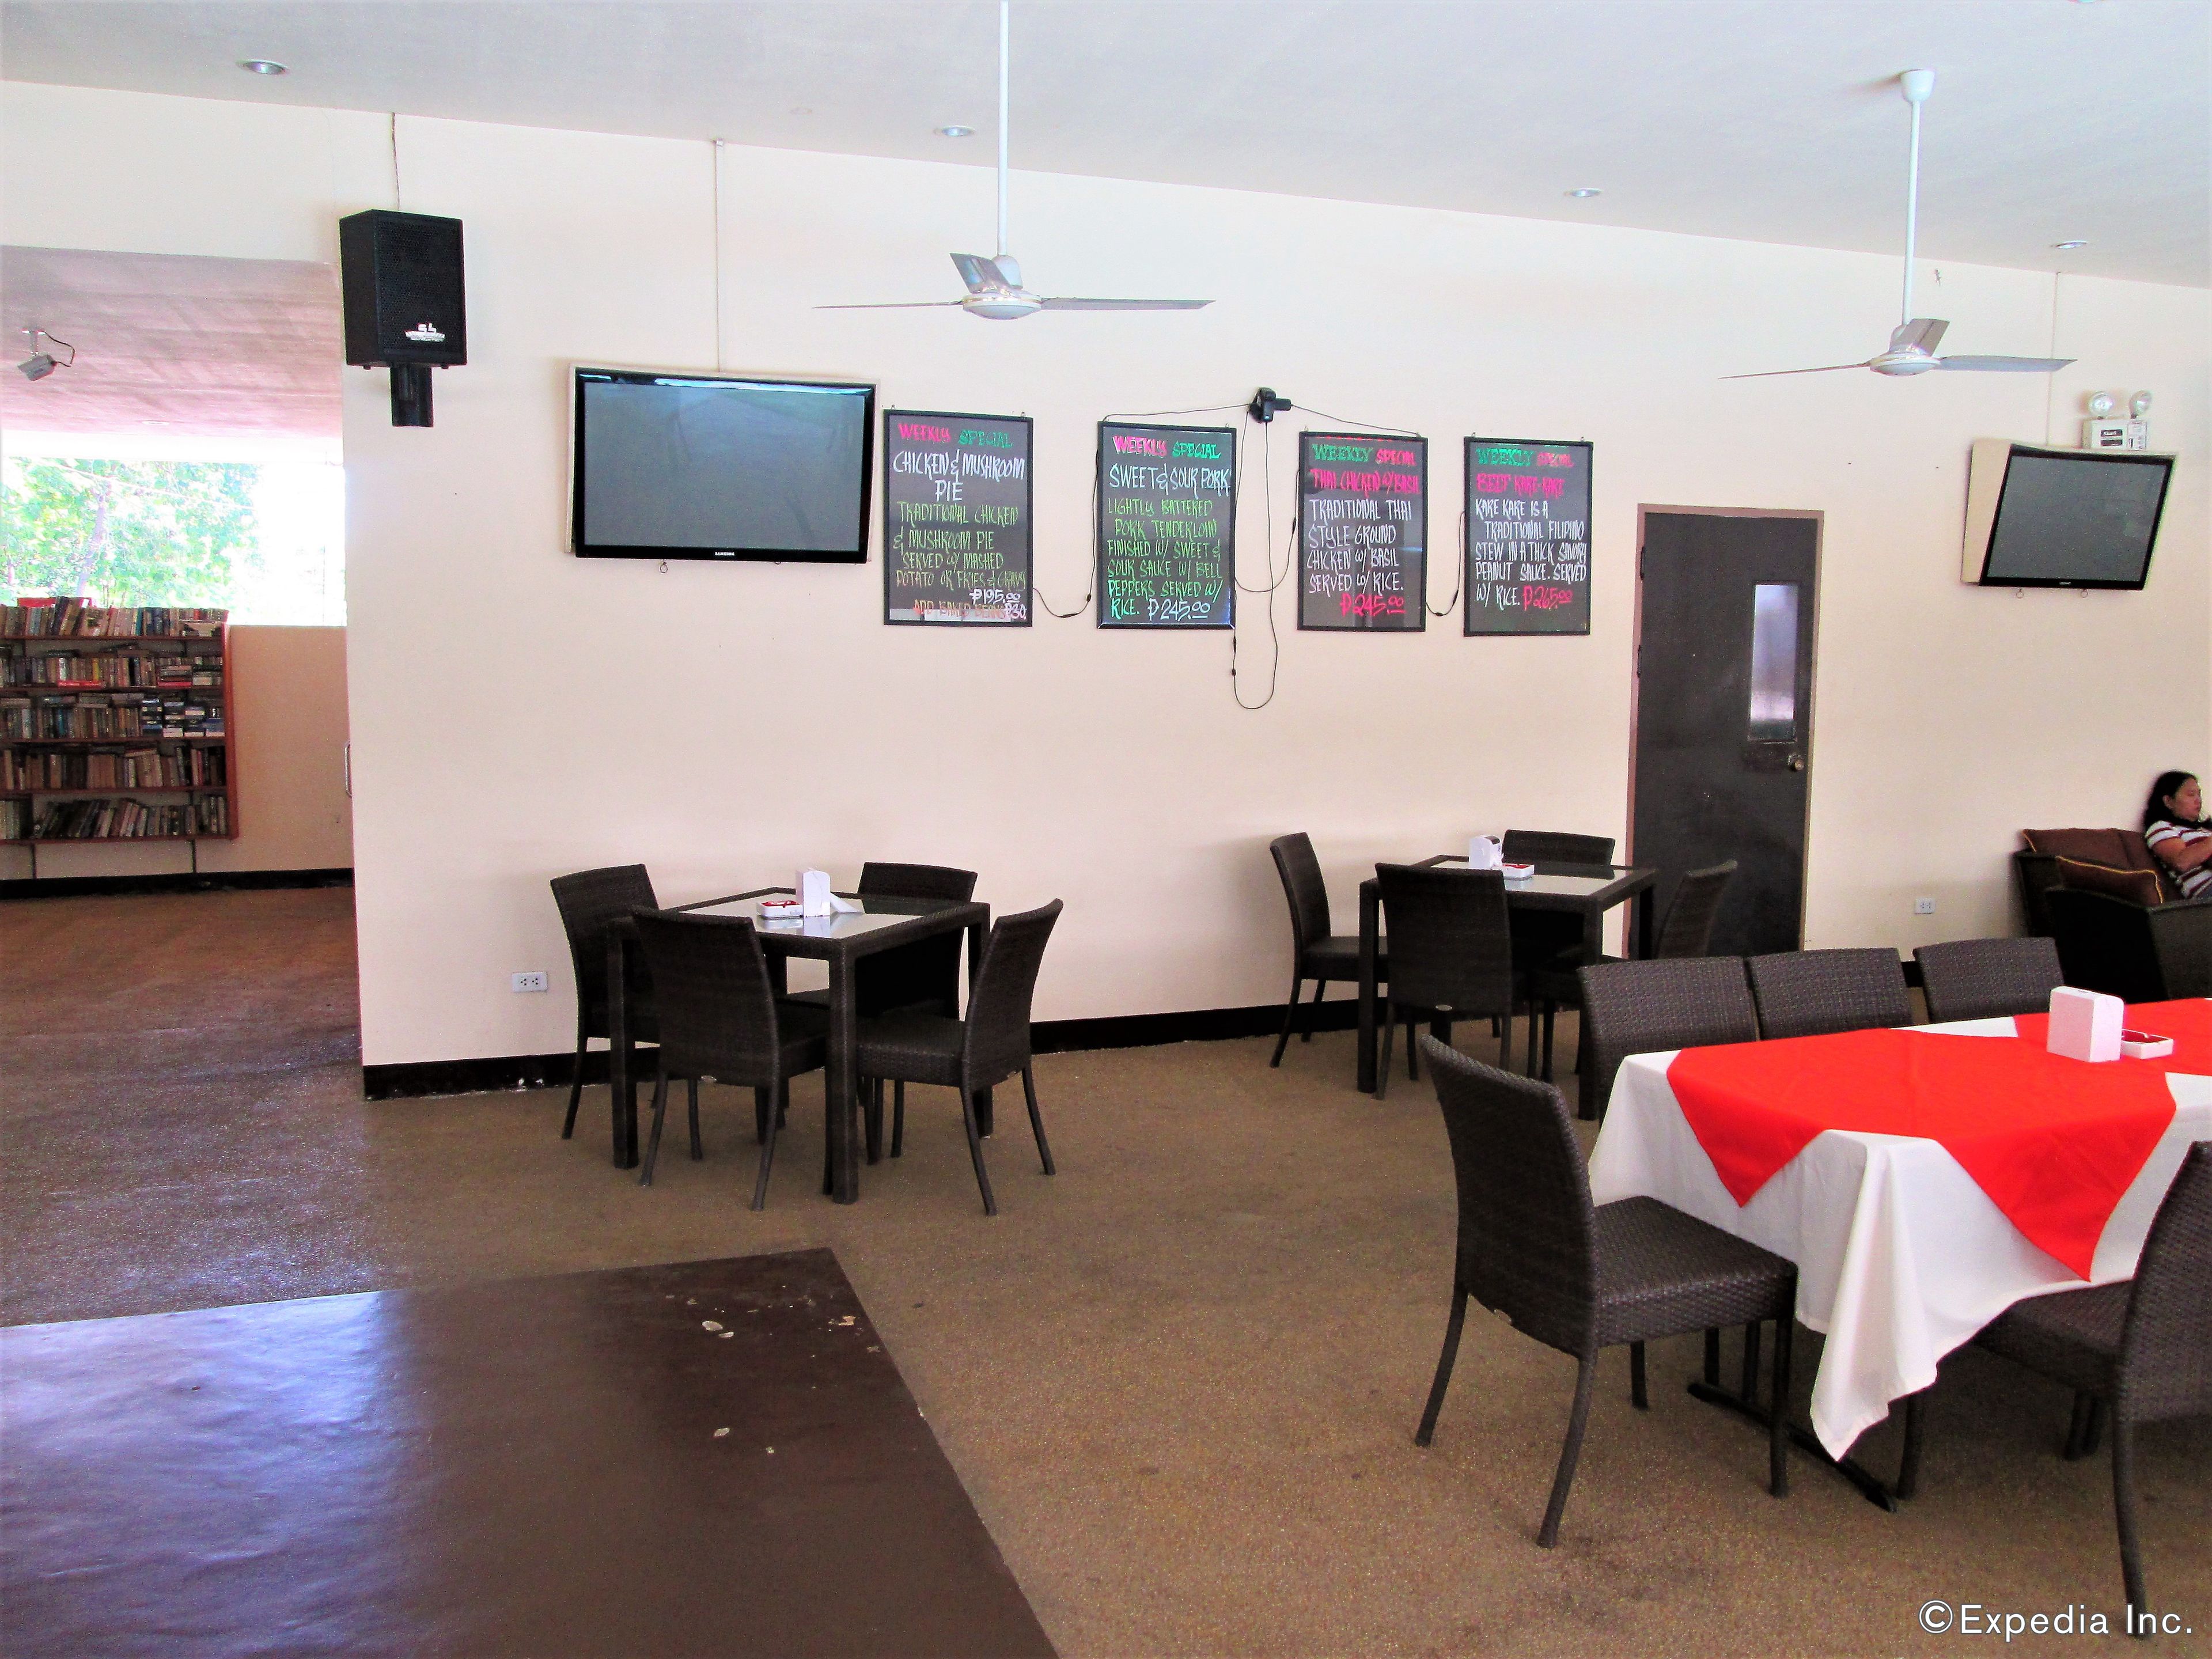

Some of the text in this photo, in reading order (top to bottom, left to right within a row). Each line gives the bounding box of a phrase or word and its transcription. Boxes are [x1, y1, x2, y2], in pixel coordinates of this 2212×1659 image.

[898, 423, 1013, 448] WEEKLY SPECIAL
[1112, 435, 1221, 459] WEEKLY SPECIAL
[893, 449, 1025, 483] CHICKEN & MUSHROOM
[1312, 444, 1416, 467] WEEKLY SPECIAL
[1476, 448, 1535, 467] WEEKLY
[935, 480, 964, 502] PIE
[1109, 463, 1232, 499] SWEET & SOUR PORK
[1309, 468, 1336, 490] THAI
[1340, 470, 1380, 499] CHICKEN
[897, 502, 1018, 527] TRADITIONAL CHICKEN
[1108, 498, 1213, 519] LIGHTLY BATTERED
[1309, 498, 1412, 525] TRADITIONAL THAI
[1531, 501, 1540, 516] IS
[1542, 501, 1548, 519] A
[893, 527, 995, 555] & MUSHROOM PIE
[1115, 518, 1217, 541] PORK TENDERLOIN
[1308, 524, 1396, 550] STYLE GROUND
[1484, 521, 1544, 541] TRADITIONAL
[1107, 539, 1151, 558] FINISHED
[1173, 539, 1209, 559] SWEET
[1307, 549, 1351, 574] CHICKEN
[1371, 547, 1399, 569] BASIL
[1475, 542, 1586, 565] STEW IN A THICK SAVORY
[903, 552, 943, 570] SERVED
[963, 553, 1003, 569] MASHED
[1107, 559, 1135, 581] SOUR
[1140, 560, 1171, 578] SAUCE
[1196, 560, 1222, 578] BELL
[896, 571, 934, 589] POTATO
[957, 573, 984, 589] FRIES
[997, 570, 1026, 590] GRAVY
[1475, 562, 1513, 581] PEANUT
[1552, 562, 1586, 585] SERVED
[1107, 579, 1156, 600] PEPPERS
[1161, 581, 1201, 601] SERVED
[1309, 574, 1352, 598] SERVED
